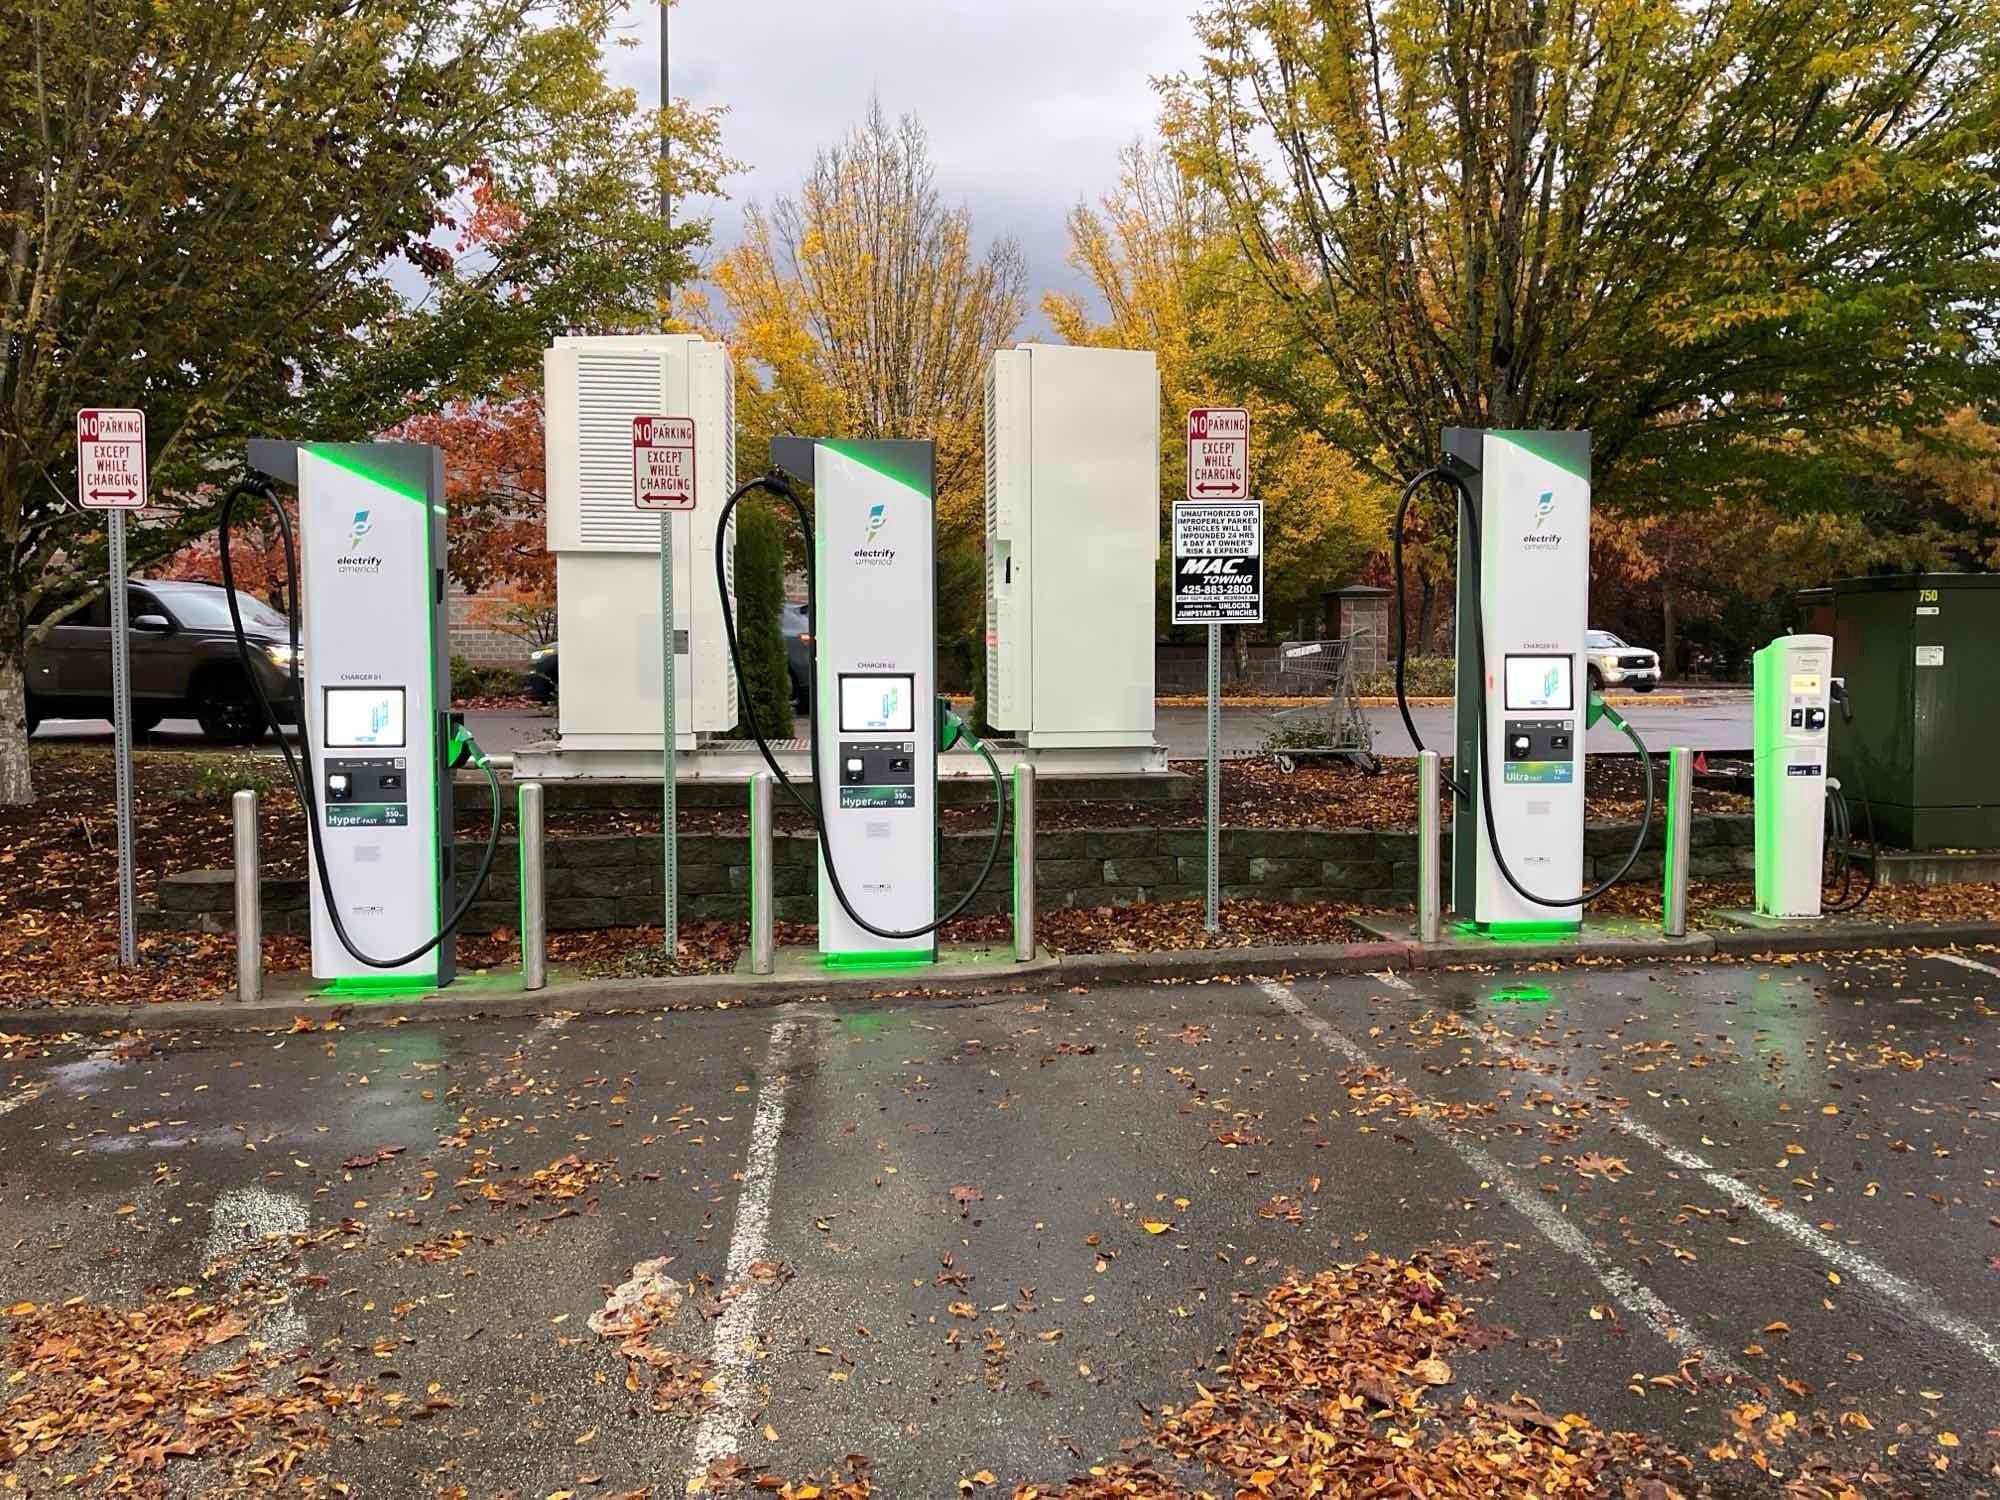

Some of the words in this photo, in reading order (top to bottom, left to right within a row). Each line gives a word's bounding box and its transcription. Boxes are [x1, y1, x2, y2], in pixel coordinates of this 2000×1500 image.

[80, 417, 98, 436] NO
[100, 421, 140, 433] PARKING
[1191, 416, 1206, 433] NO
[1208, 419, 1245, 431] PARKING
[634, 424, 651, 441] NO
[653, 427, 691, 439] PARKING
[94, 446, 130, 458] EXCEPT
[1202, 442, 1235, 454] EXCEPT
[647, 451, 682, 463] EXCEPT
[1204, 455, 1232, 467] WHILE
[97, 460, 127, 472] WHILE
[650, 465, 680, 476] WHILE
[87, 473, 138, 486] CHARGING
[1194, 468, 1241, 480] CHARGING
[640, 478, 690, 490] CHARGING
[1523, 534, 1562, 544] electrify
[854, 548, 895, 558] electrify
[337, 555, 382, 566] electrify
[1180, 558, 1245, 574] MAC
[1203, 575, 1253, 584] TOWING
[1182, 585, 1253, 594] 425-883-2800
[1919, 590, 1938, 602] 750
